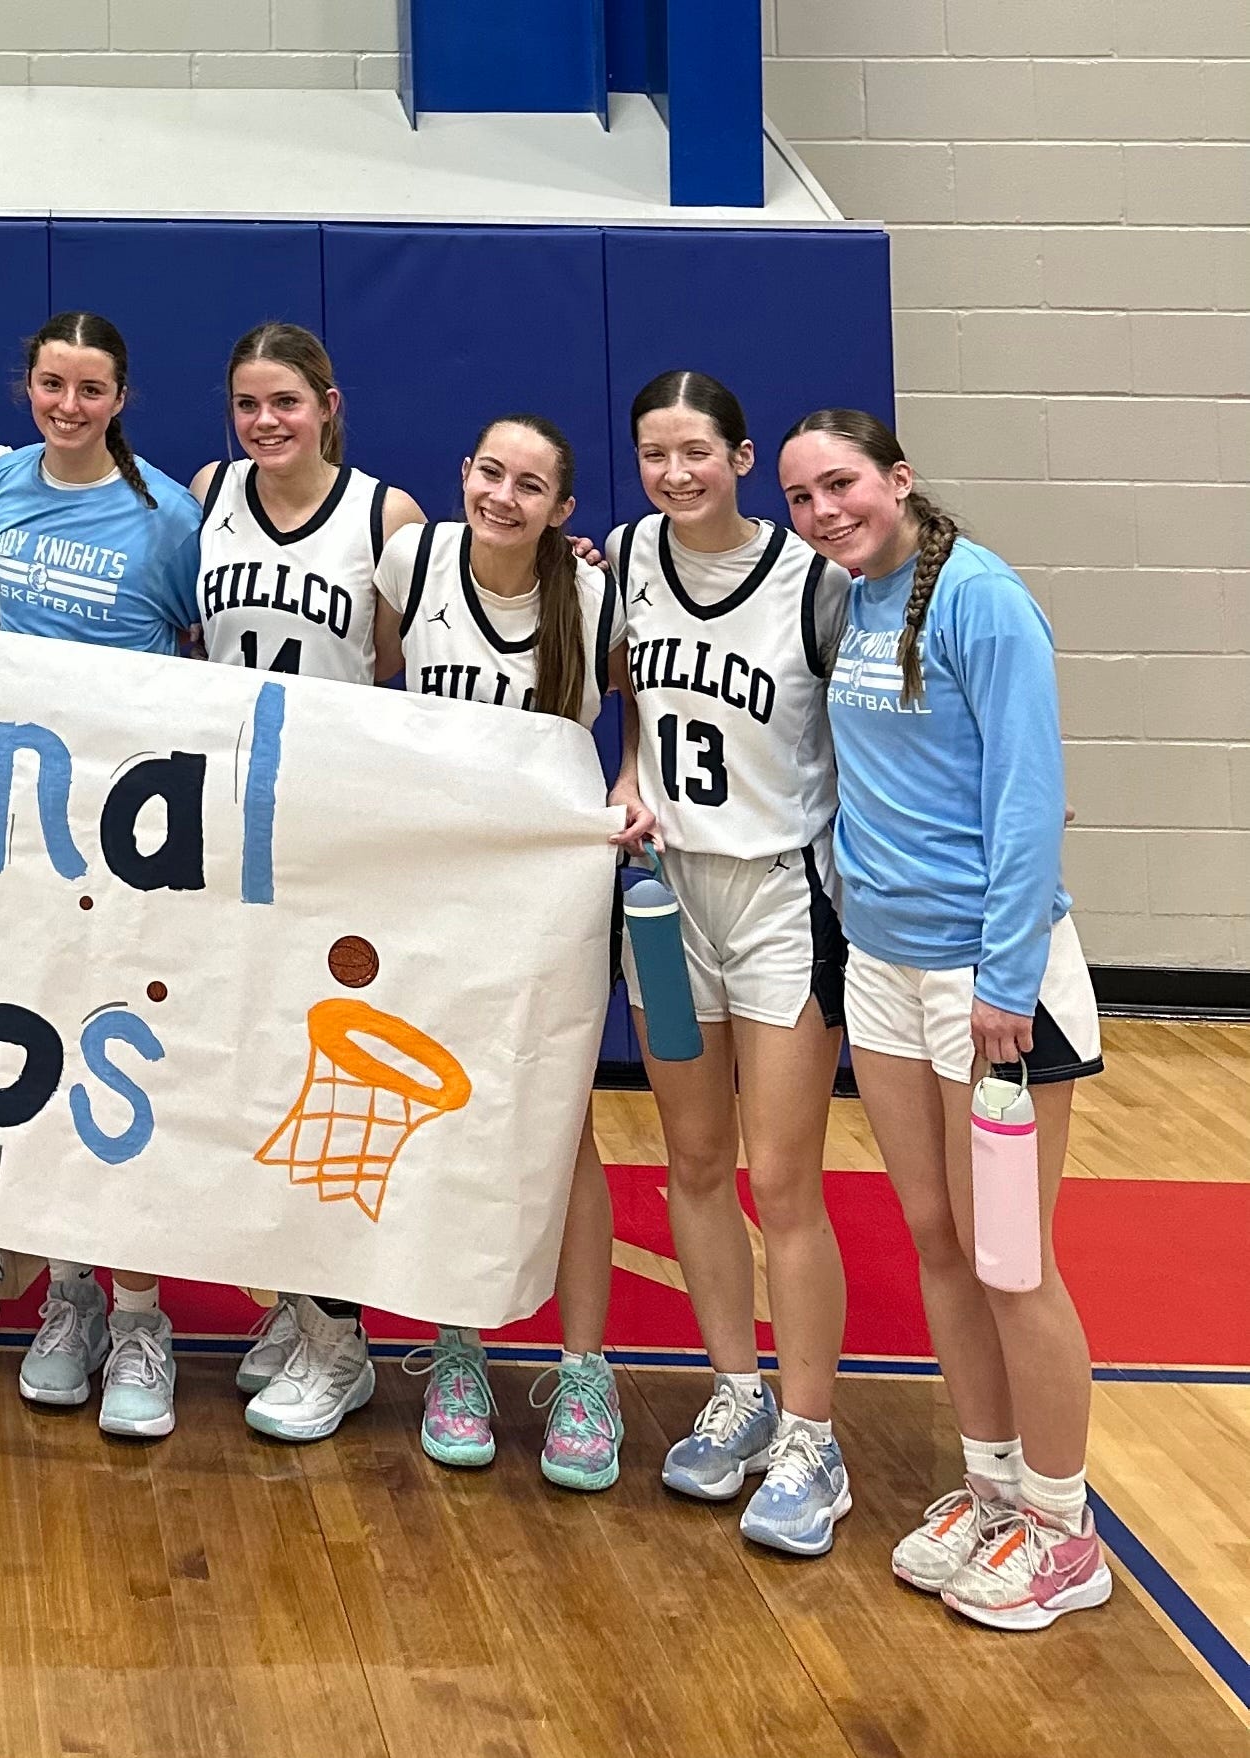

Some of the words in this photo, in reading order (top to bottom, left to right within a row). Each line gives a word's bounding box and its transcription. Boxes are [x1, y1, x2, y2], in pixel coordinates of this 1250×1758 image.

[33, 534, 128, 580] KNIGHTS
[204, 562, 353, 639] HILLCO
[421, 665, 535, 711] HILL
[630, 638, 776, 724] HILLCO
[827, 687, 932, 714] SKETBALL
[658, 713, 728, 807] 13
